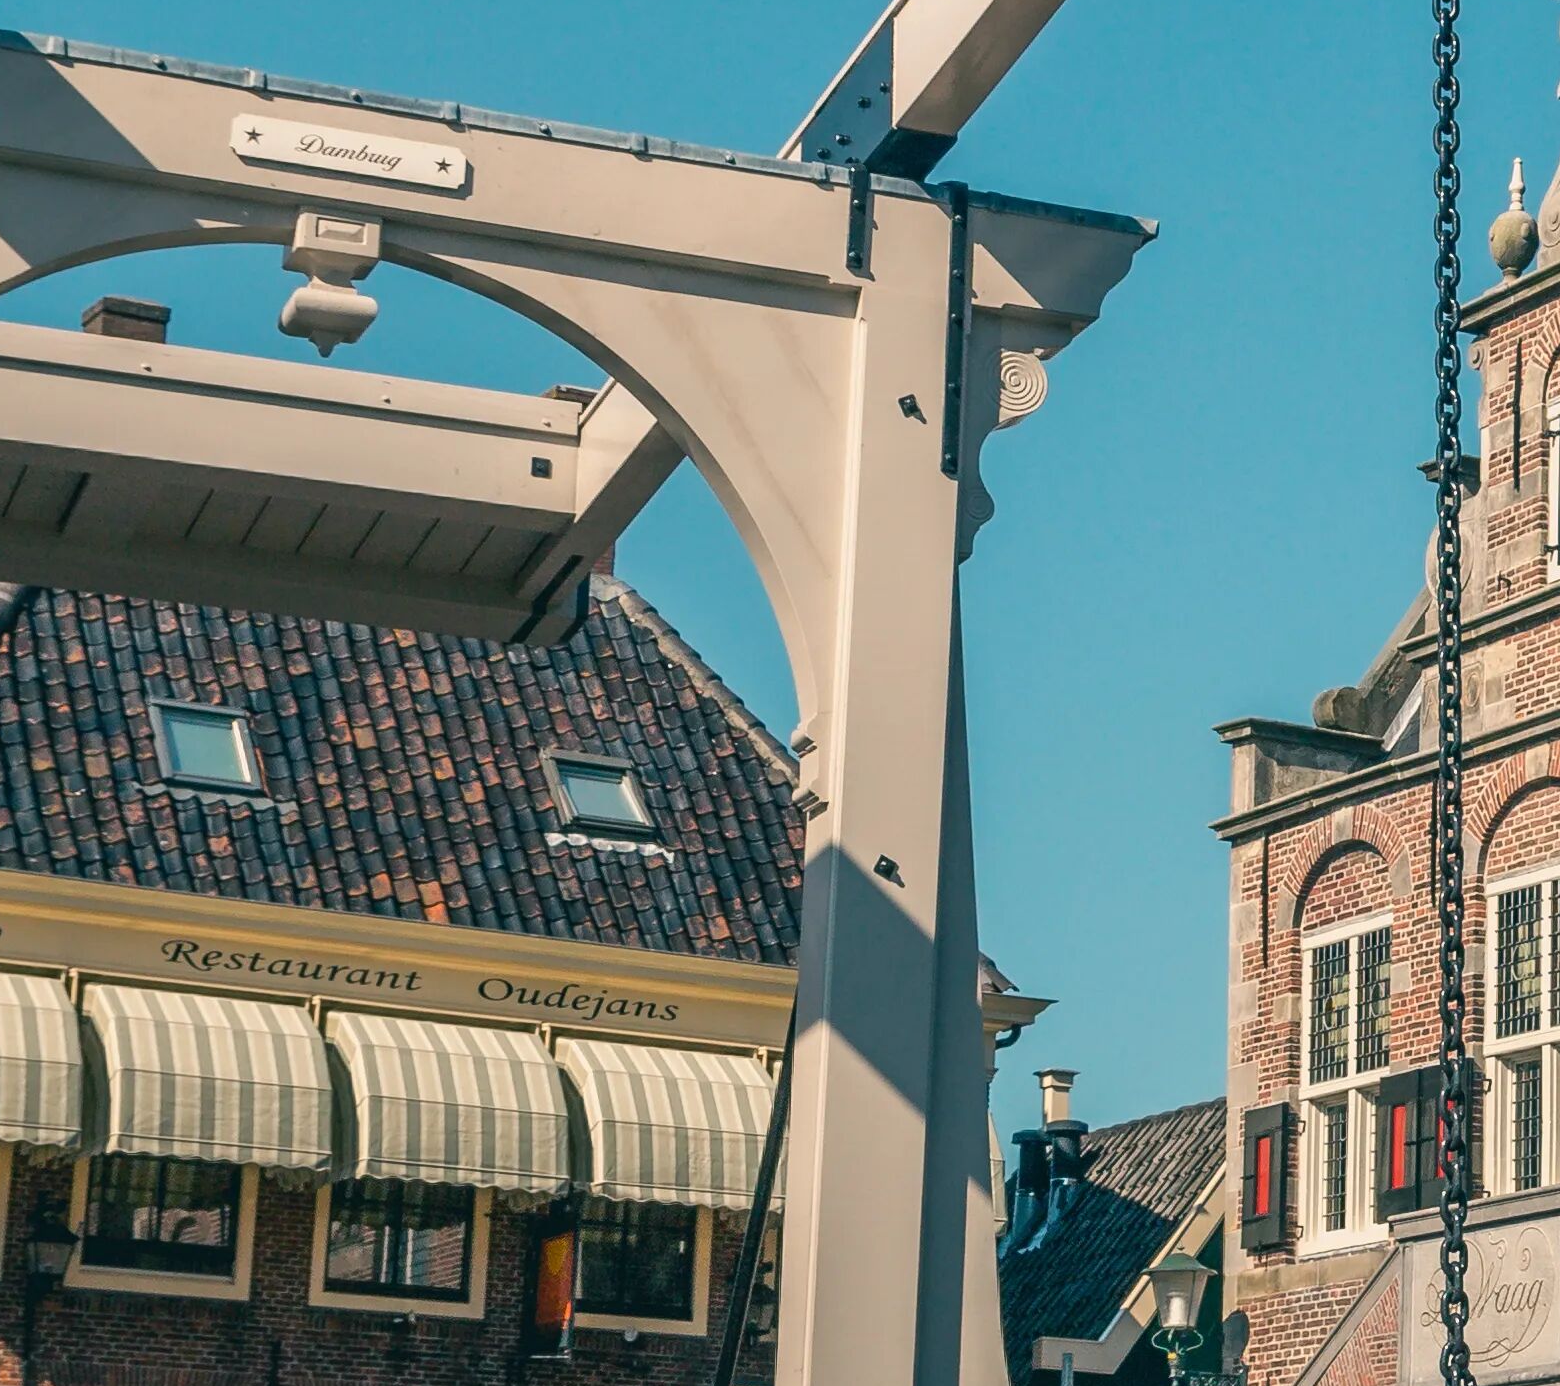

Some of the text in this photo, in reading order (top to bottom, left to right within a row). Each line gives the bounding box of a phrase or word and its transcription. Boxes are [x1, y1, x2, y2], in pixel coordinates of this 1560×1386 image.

[295, 134, 403, 172] Dambrug
[160, 939, 422, 991] Restaurant
[477, 978, 679, 1021] Oudejans
